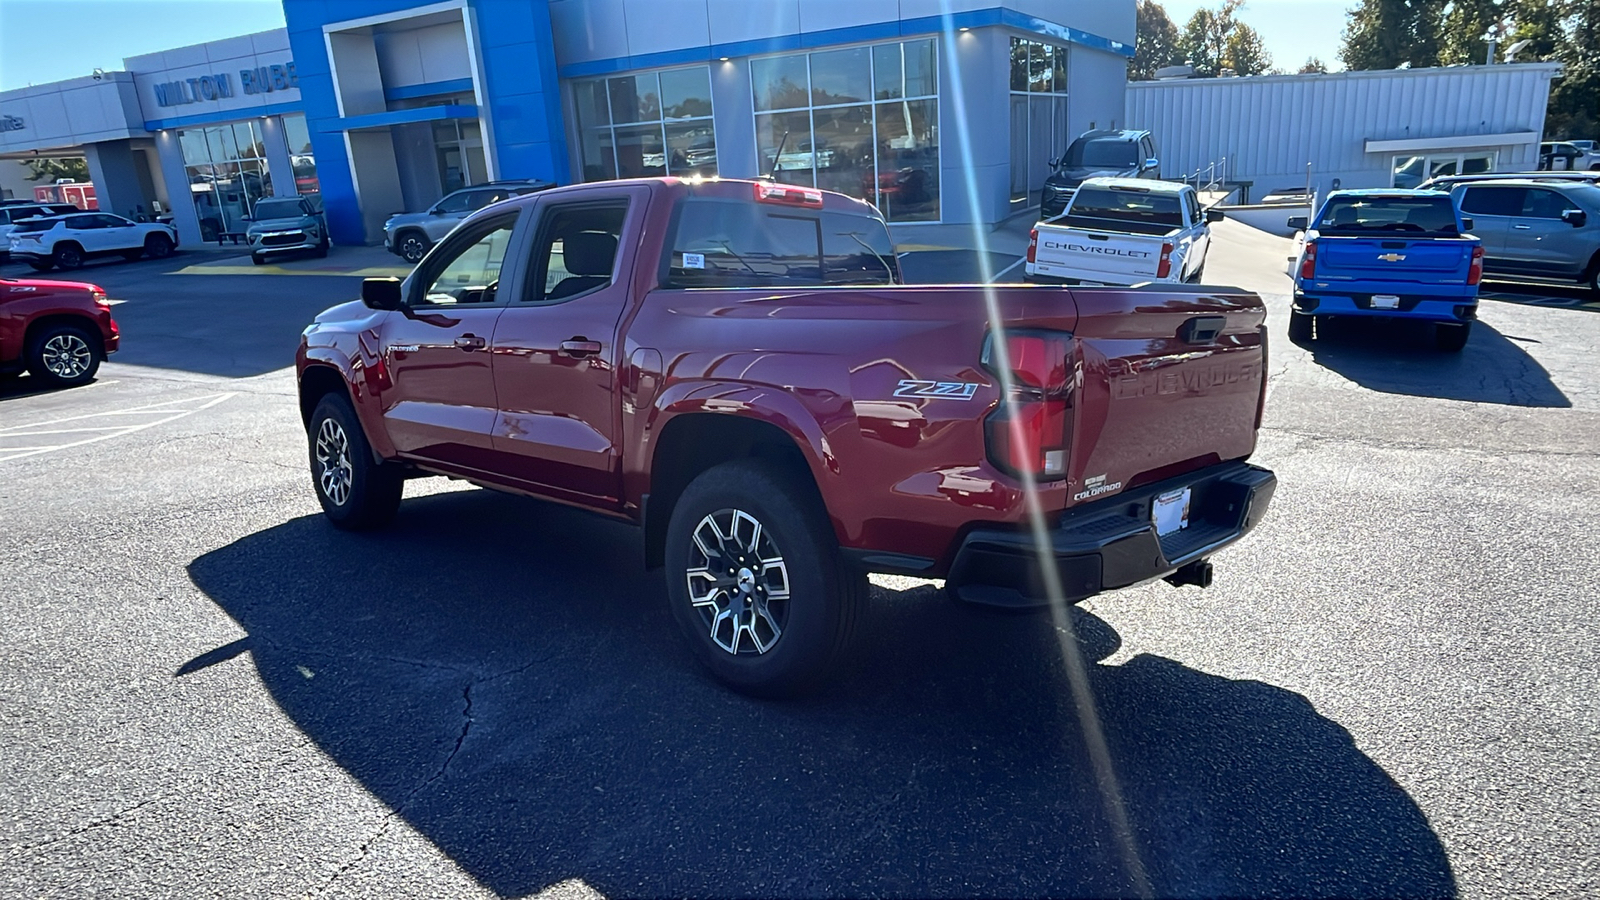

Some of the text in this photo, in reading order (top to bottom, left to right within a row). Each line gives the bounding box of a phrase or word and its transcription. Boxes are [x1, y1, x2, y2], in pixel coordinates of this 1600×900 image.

[153, 73, 234, 107] MILTON
[1044, 241, 1151, 259] CHEVROLET
[893, 379, 979, 401] Z71
[1115, 361, 1261, 401] CHEVROLET
[1073, 481, 1122, 501] COLORADO
